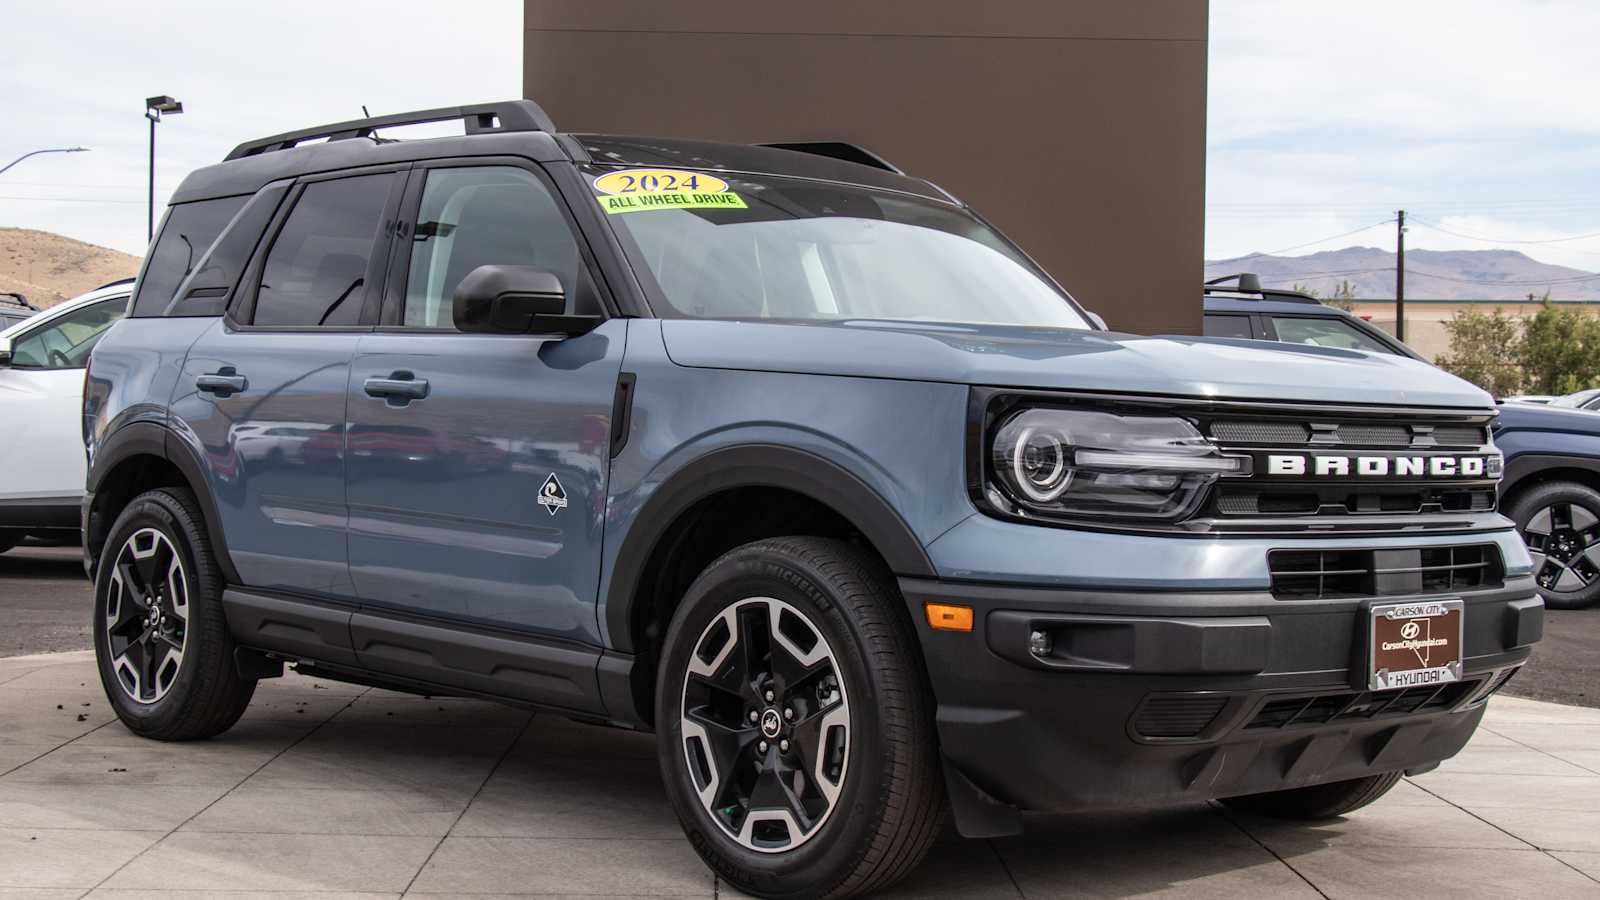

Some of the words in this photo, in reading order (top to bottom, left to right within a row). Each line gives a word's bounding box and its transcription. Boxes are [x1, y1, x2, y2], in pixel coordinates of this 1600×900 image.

[619, 175, 700, 193] 2024
[609, 197, 636, 209] ALL
[638, 194, 691, 206] WHEEL
[693, 193, 737, 204] DRIVE
[1268, 455, 1484, 476] BRONCO
[1395, 606, 1424, 617] CARSON
[1425, 605, 1441, 615] CITY
[1395, 670, 1440, 686] HYUNDAI
